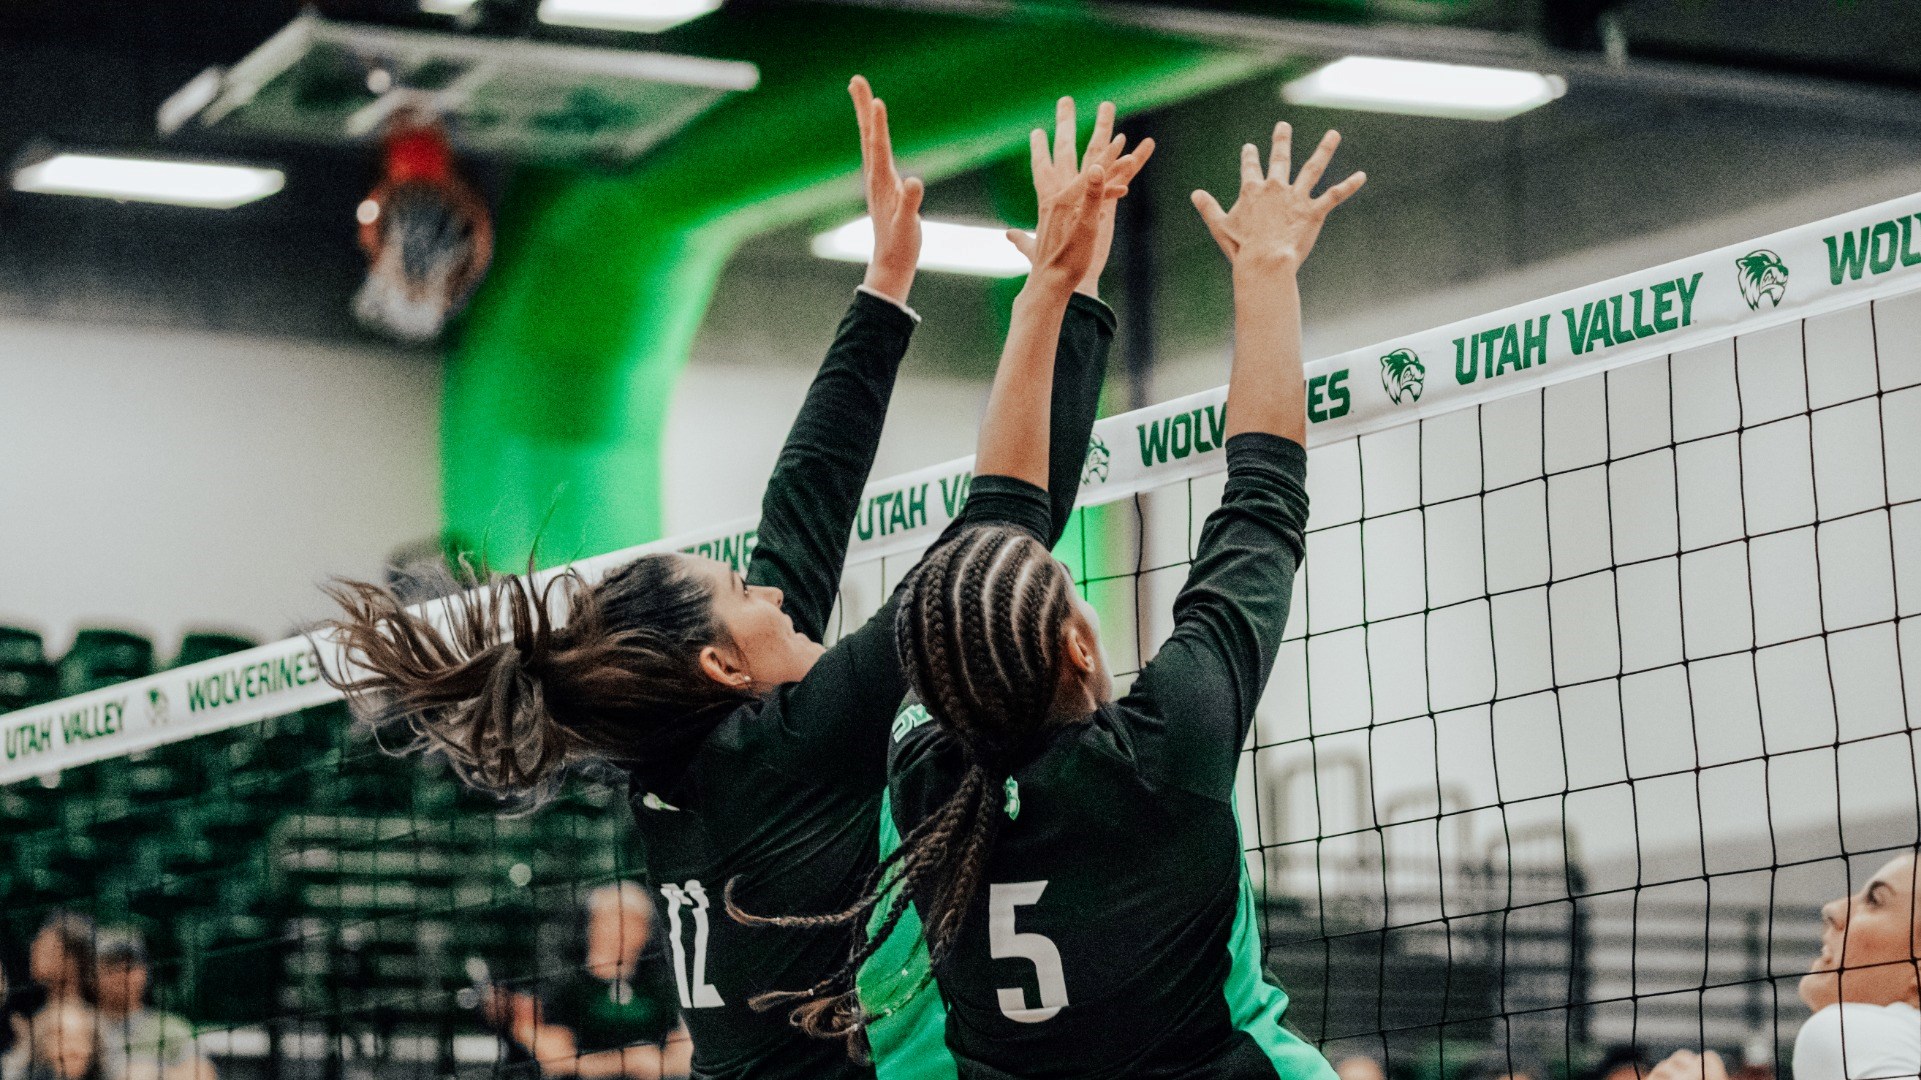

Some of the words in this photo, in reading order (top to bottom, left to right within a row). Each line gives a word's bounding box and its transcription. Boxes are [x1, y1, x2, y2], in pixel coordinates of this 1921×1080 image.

[1823, 212, 1921, 285] WOL
[1452, 314, 1551, 385] UTAH
[1561, 272, 1703, 355] VALLEY
[1137, 369, 1350, 467] WOLVES
[856, 482, 928, 541] UTAH
[187, 652, 320, 712] WOLVERINES
[5, 722, 51, 759] UTAH
[60, 700, 129, 745] VALLEY
[989, 880, 1069, 1023] 5
